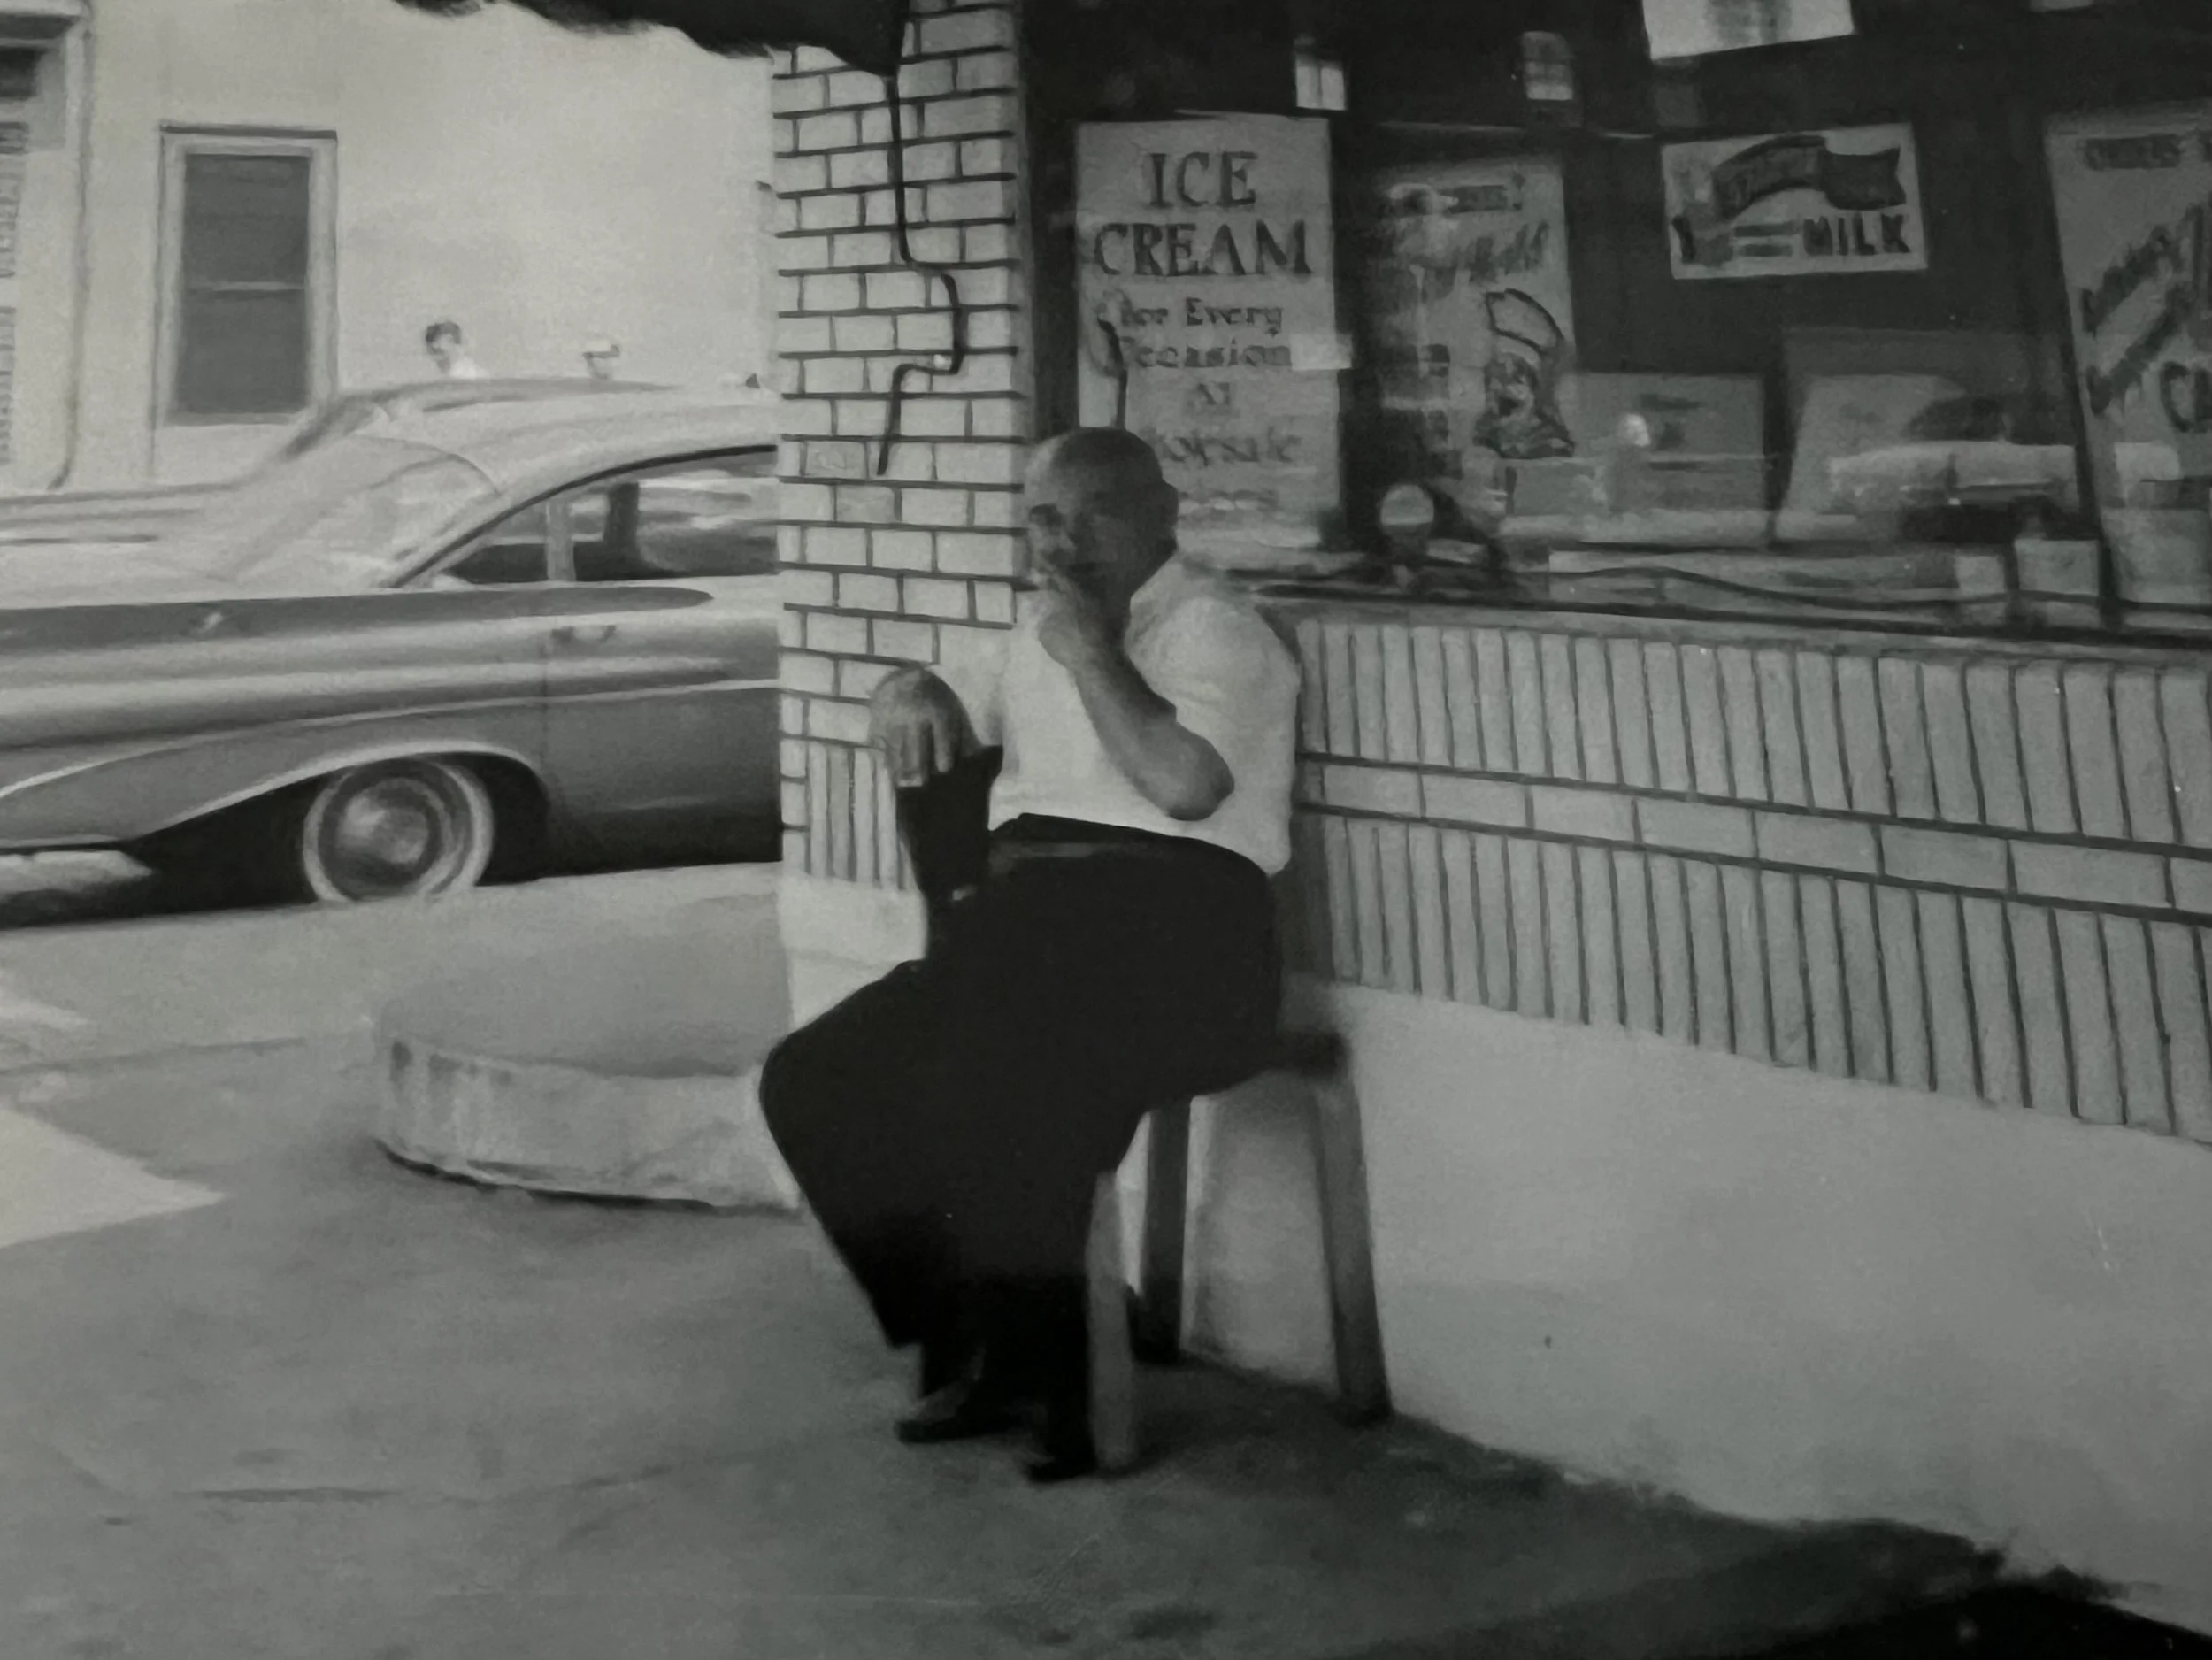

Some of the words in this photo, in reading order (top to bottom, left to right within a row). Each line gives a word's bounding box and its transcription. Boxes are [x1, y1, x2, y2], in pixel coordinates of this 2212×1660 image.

[1148, 150, 1258, 209] ICE
[1094, 220, 1312, 278] CREAM
[1804, 213, 1911, 256] MILK
[1186, 297, 1283, 337] Every
